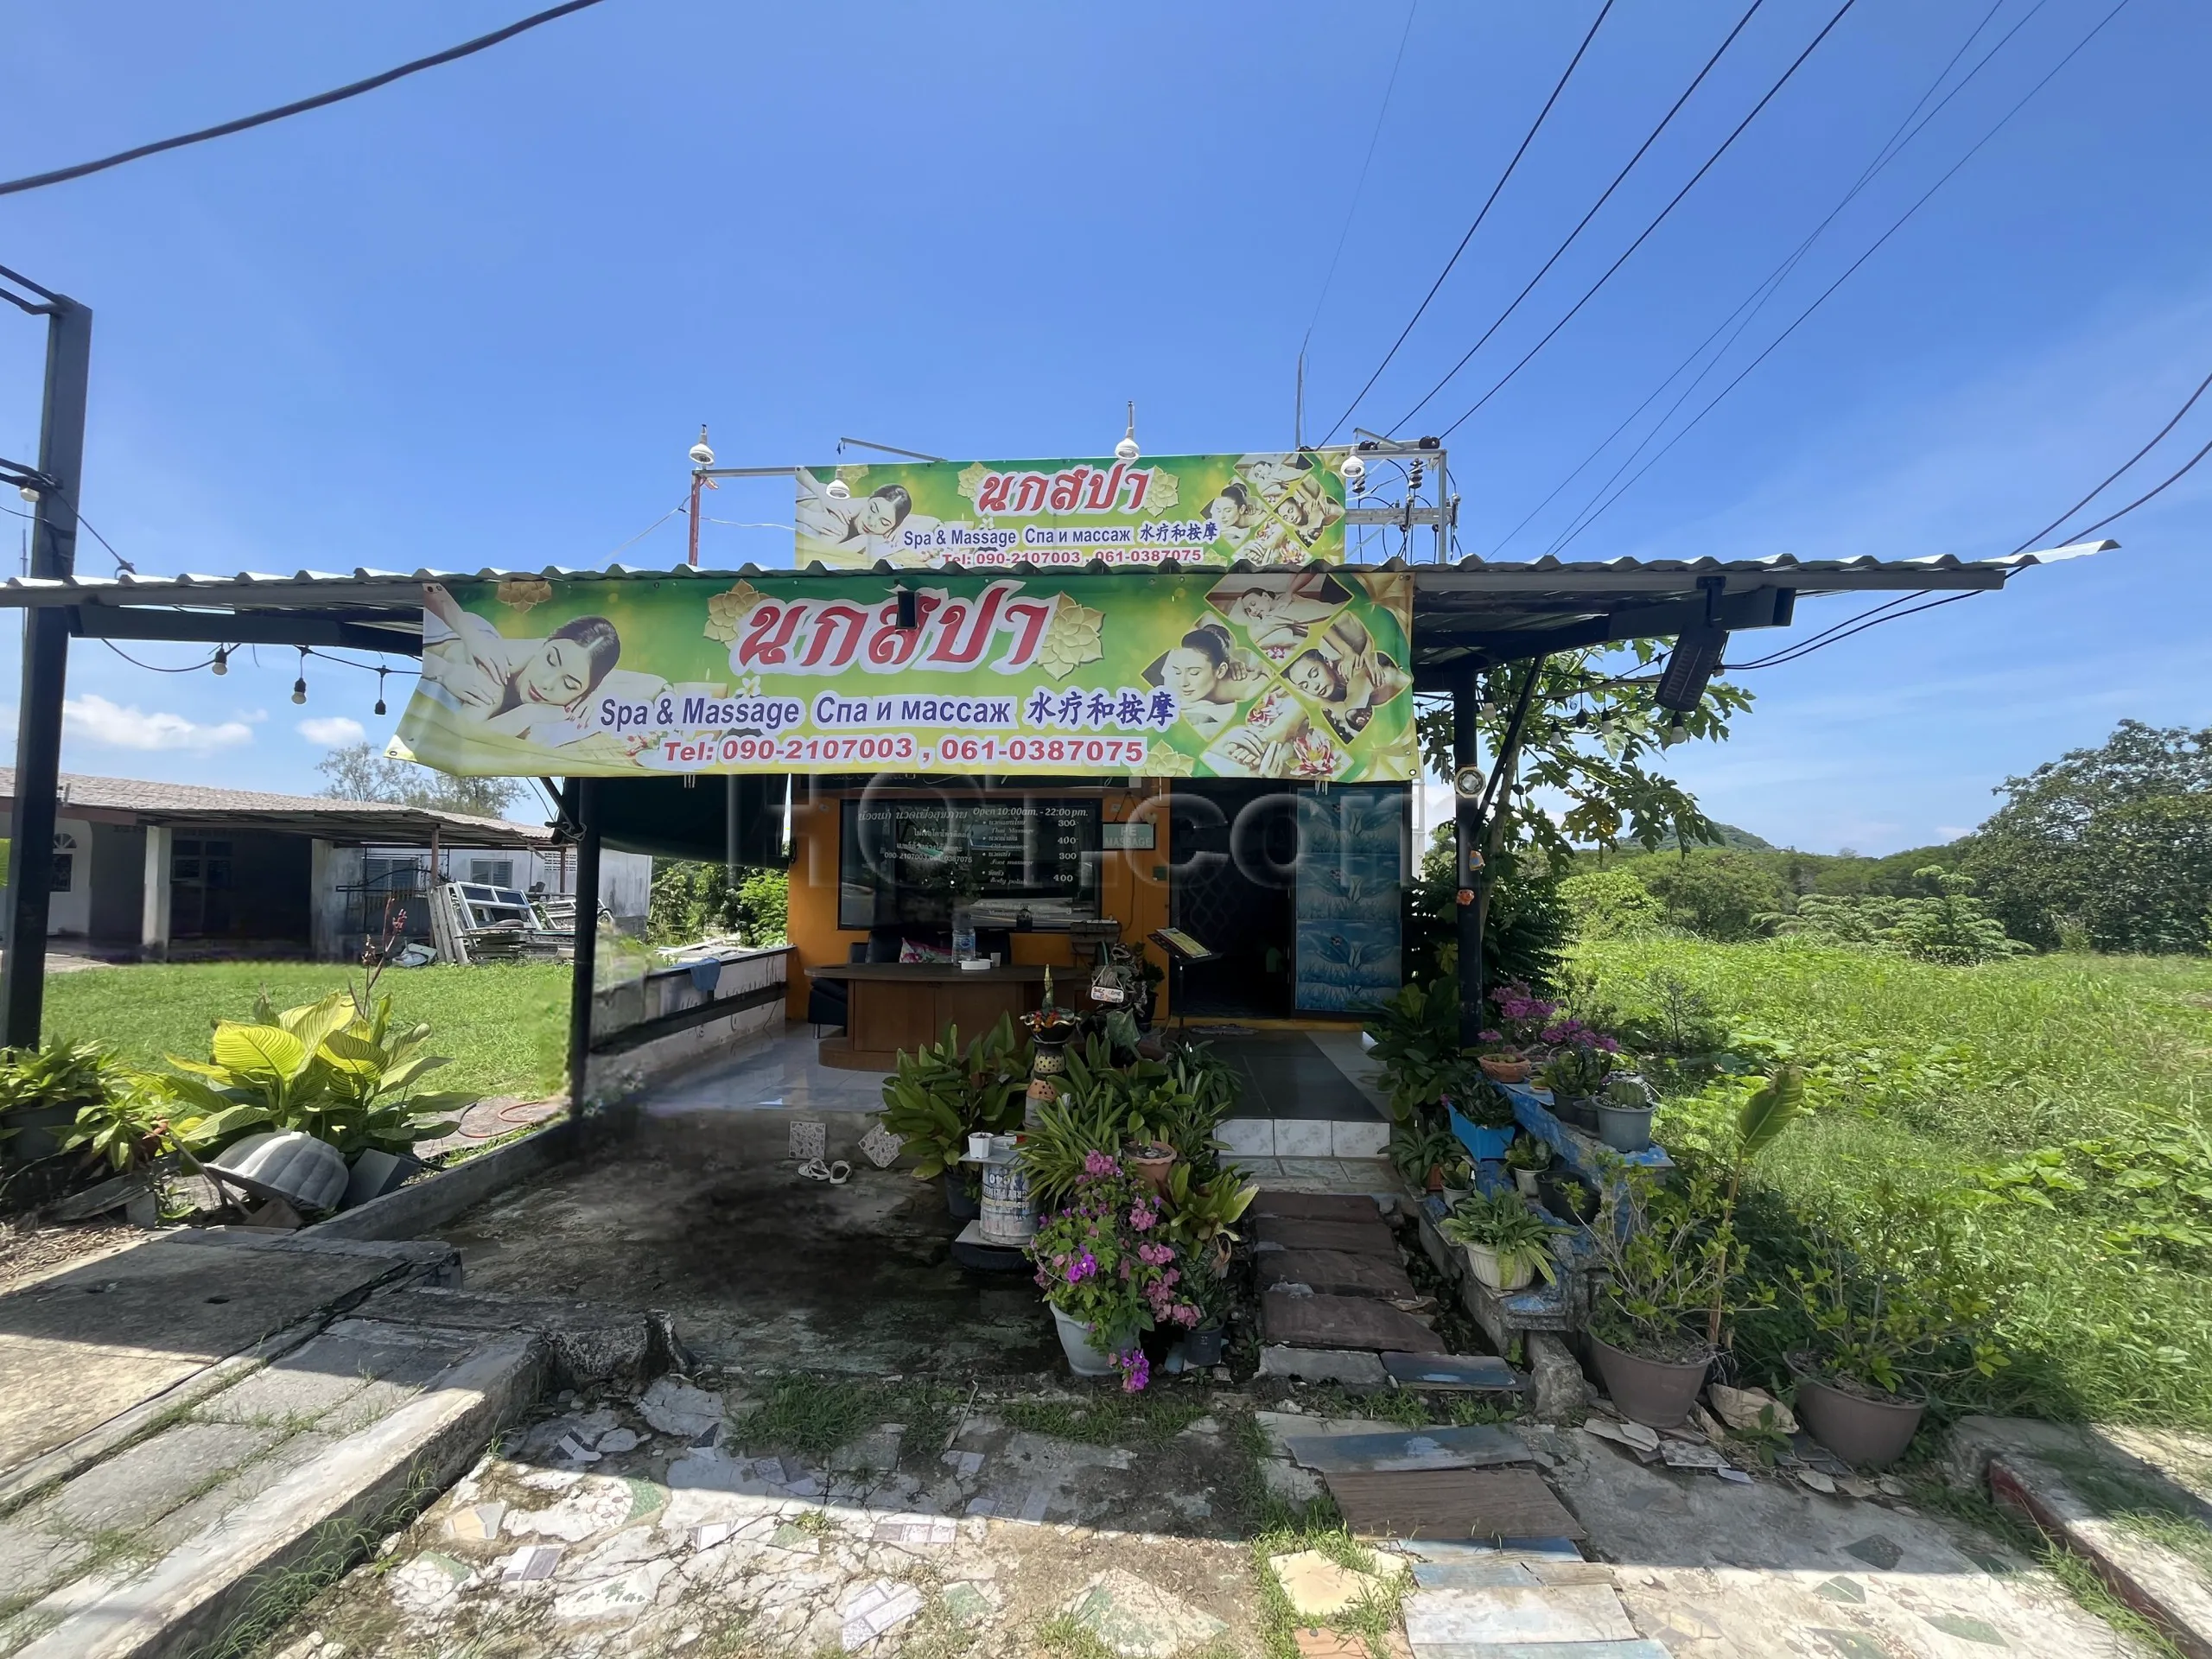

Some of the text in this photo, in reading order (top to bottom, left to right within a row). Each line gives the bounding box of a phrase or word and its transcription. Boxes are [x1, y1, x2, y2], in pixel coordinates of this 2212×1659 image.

[979, 463, 1148, 512] นกสปา
[904, 522, 1218, 548] Spa & Massage Спа и массаж 水疗和按摩
[976, 551, 1081, 564] 090-2107003
[740, 588, 1049, 666] นกสปา
[601, 690, 1176, 730] Spa & Massage Спа и массаж 水疗和按摩
[664, 741, 714, 762] Tel:
[722, 737, 912, 760] 090-2107003
[941, 739, 1143, 762] 061-0387075
[973, 807, 995, 817] Open
[1105, 837, 1152, 847] MASSAGE
